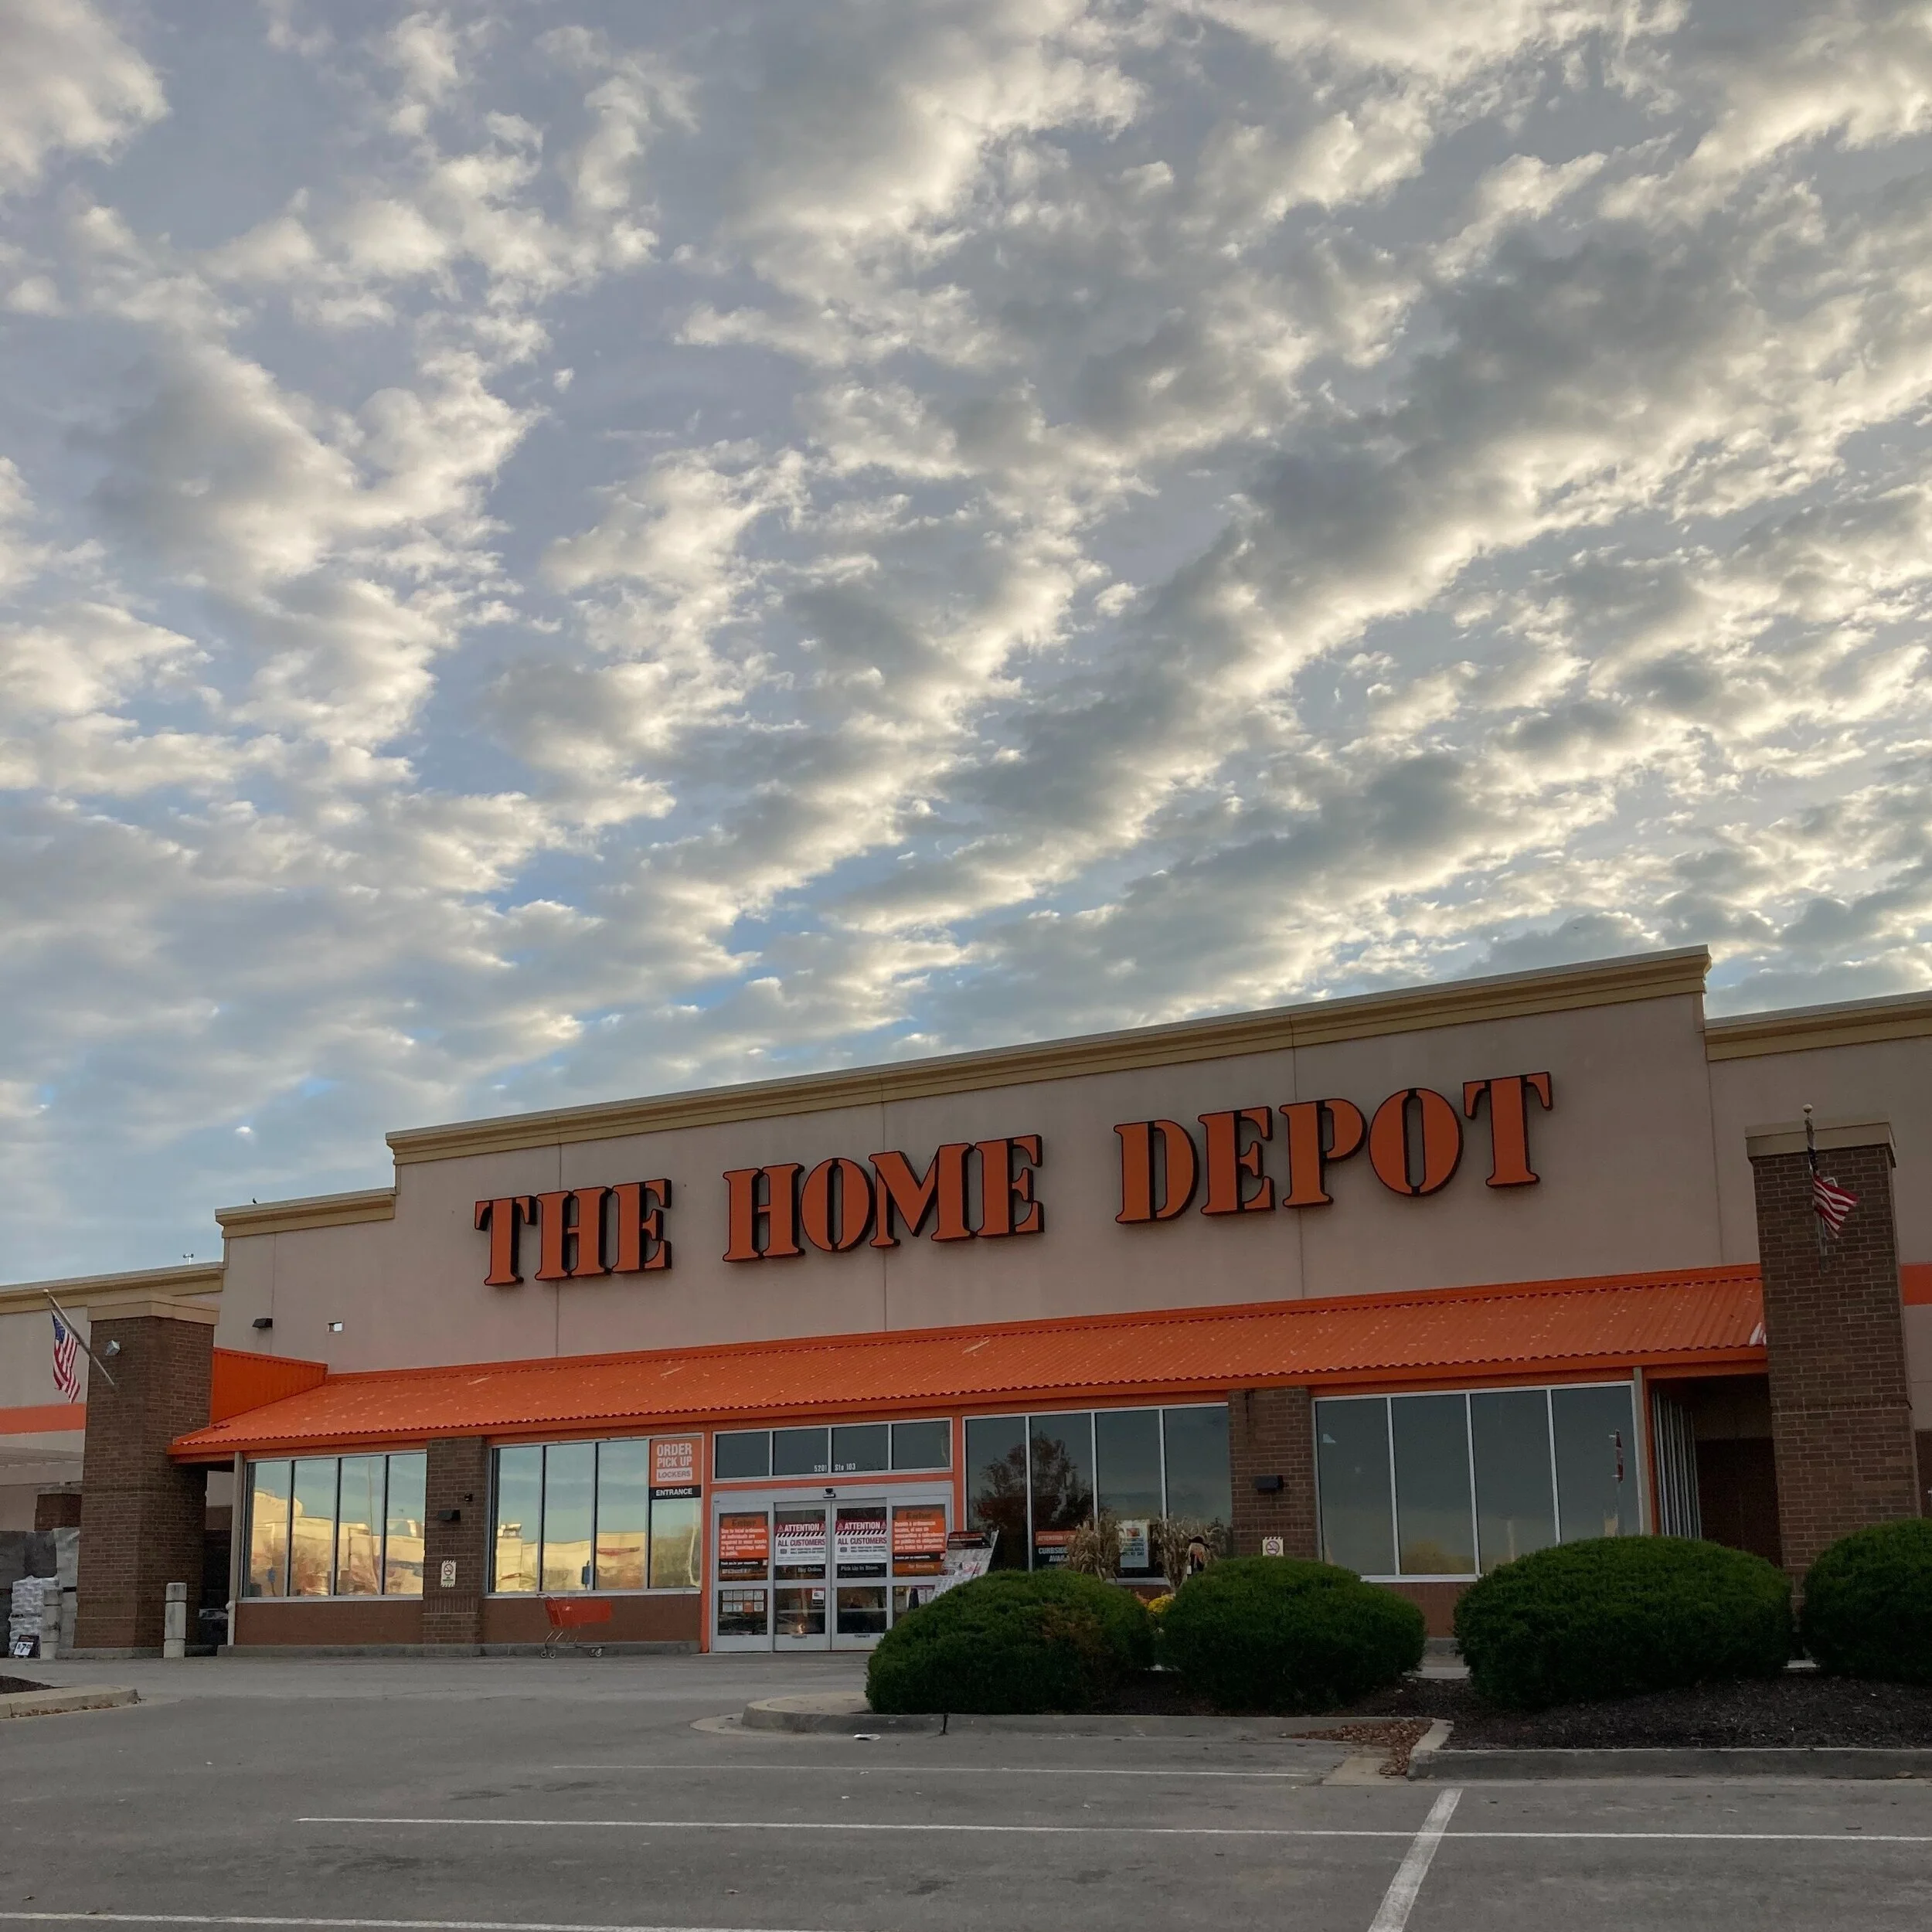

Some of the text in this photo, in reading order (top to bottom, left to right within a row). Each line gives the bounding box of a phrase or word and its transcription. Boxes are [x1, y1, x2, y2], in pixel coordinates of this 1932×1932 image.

[474, 1071, 1553, 1286] THE HOME DEPOT
[657, 1443, 692, 1457] ORDER
[657, 1456, 692, 1468] PICK UP
[658, 1470, 691, 1478] LOCKERS
[655, 1488, 693, 1497] ENTRANCE
[784, 1523, 820, 1532] ATTENTION
[844, 1522, 880, 1530] ATTENTION
